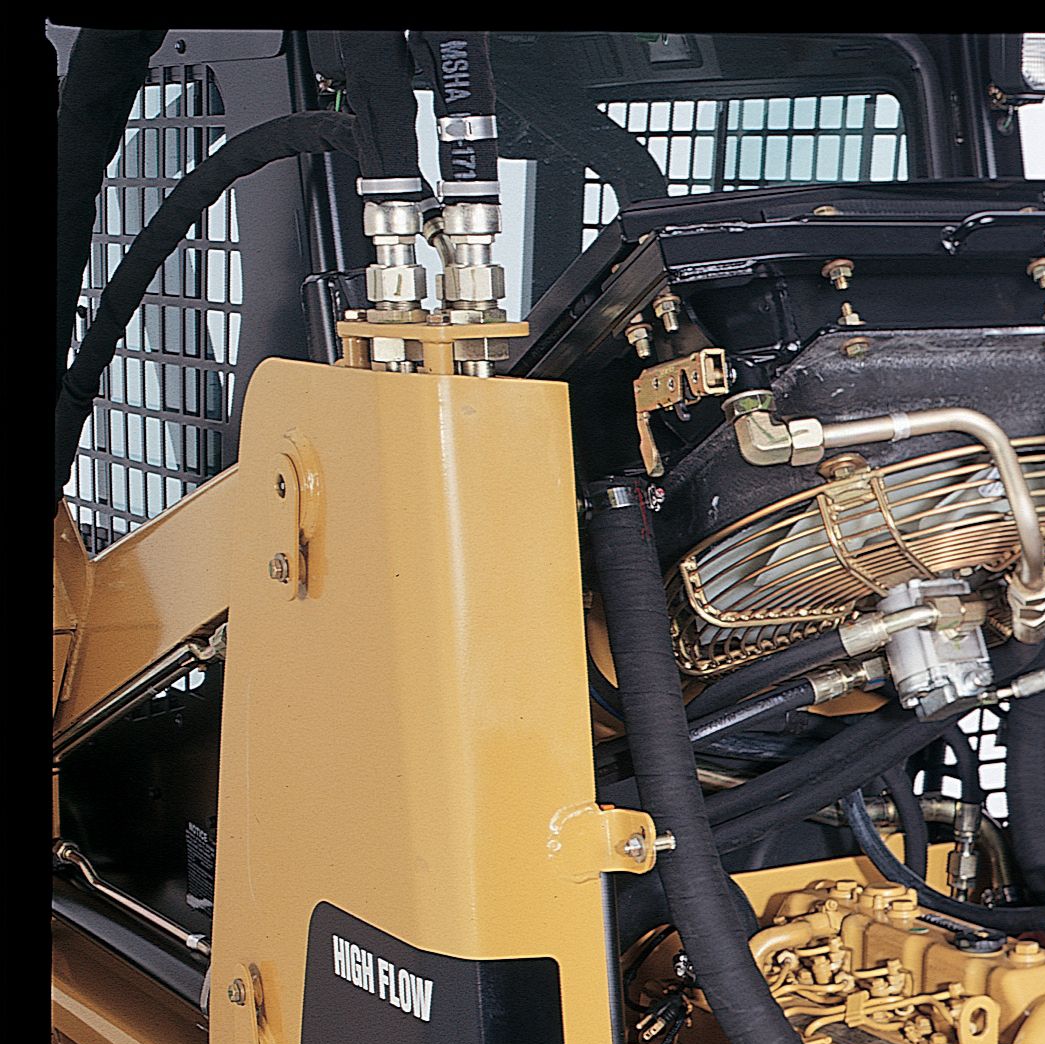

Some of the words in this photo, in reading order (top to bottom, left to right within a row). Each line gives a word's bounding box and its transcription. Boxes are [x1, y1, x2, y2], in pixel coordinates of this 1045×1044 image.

[440, 40, 472, 104] MSHA
[332, 935, 376, 994] HIGH
[377, 957, 434, 1022] FLOW
